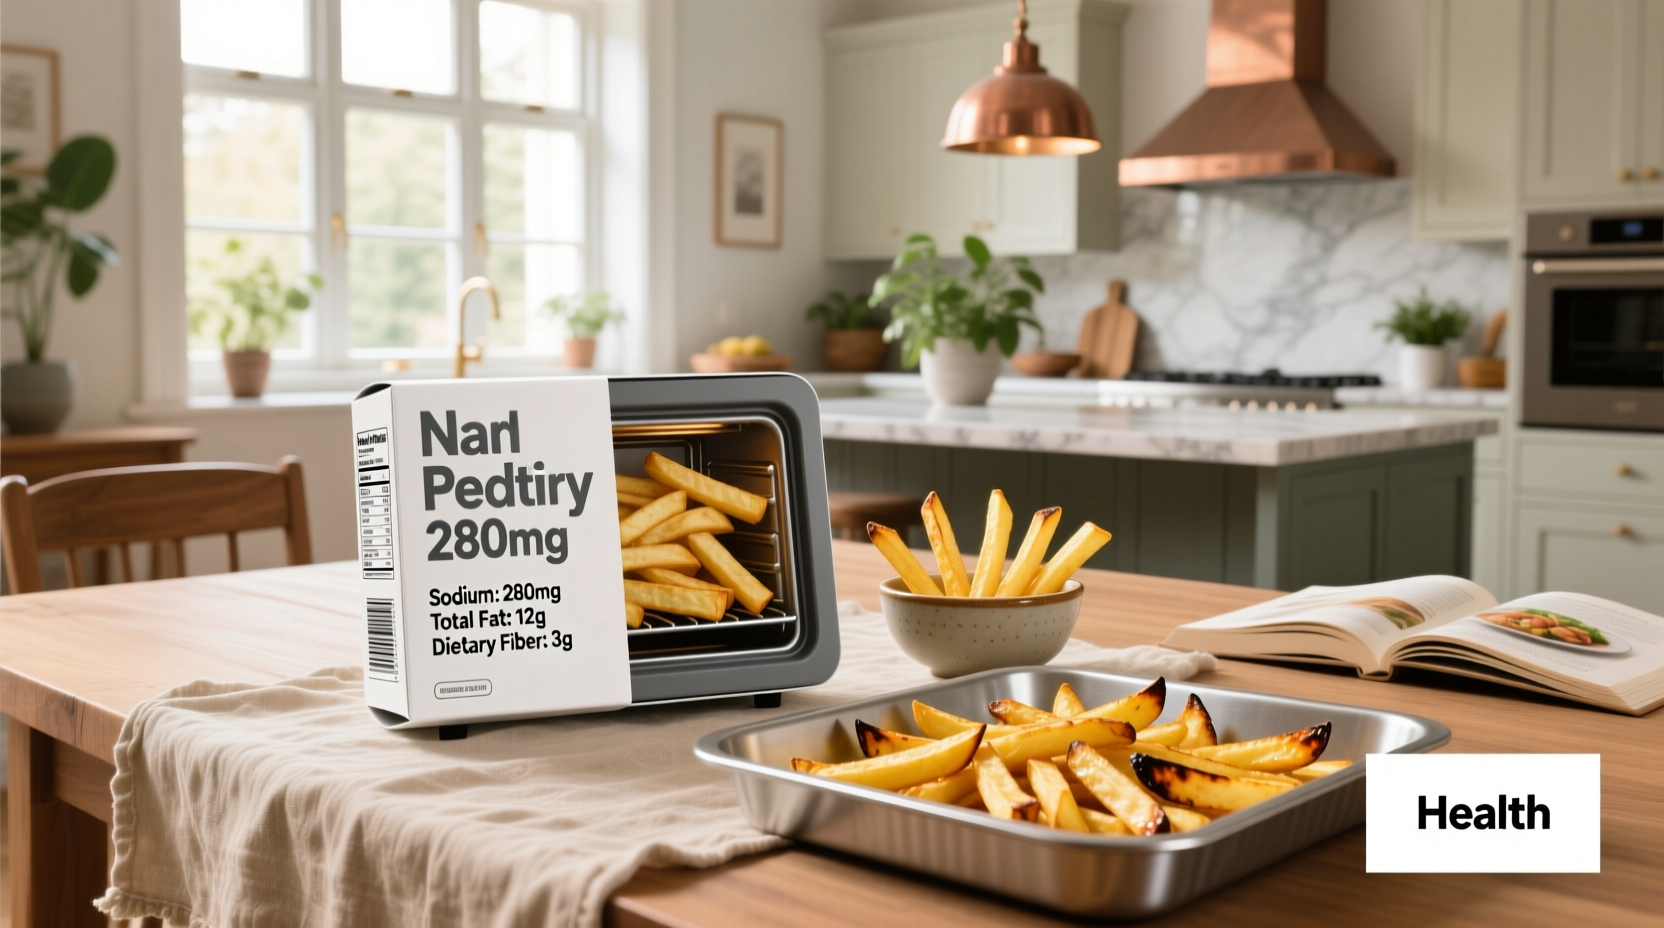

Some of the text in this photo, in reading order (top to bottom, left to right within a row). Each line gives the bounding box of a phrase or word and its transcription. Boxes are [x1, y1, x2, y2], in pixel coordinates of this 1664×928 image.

[422, 460, 594, 518] Pedtiry
[425, 517, 569, 565] 280mg
[429, 582, 562, 607] Sodium: 280mg
[429, 606, 547, 631] Total Fat: 12g
[432, 629, 573, 658] Dietary Fiber: 3g
